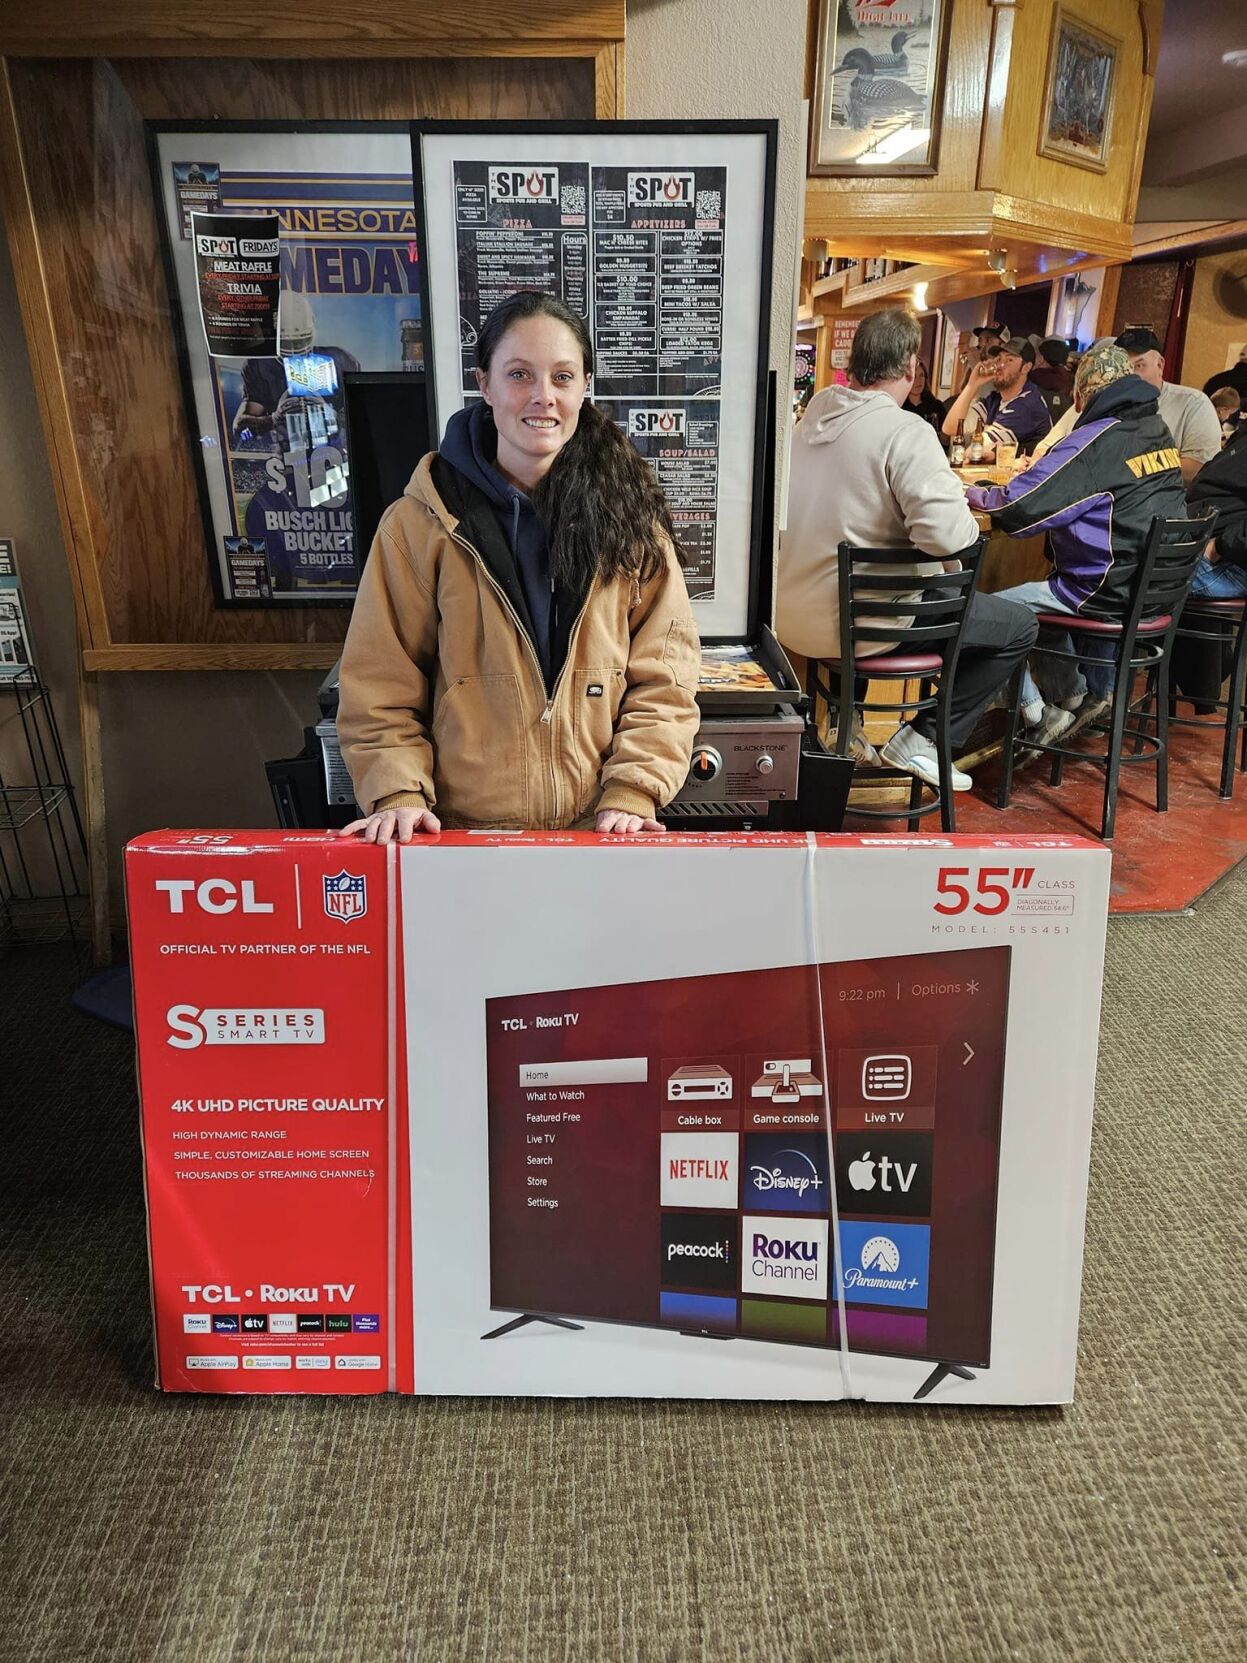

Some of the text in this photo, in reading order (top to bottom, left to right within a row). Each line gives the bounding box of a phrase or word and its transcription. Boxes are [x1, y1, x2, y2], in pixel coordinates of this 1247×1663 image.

[496, 170, 555, 197] SPOT
[635, 176, 692, 200] SPOT
[270, 209, 417, 232] NNESOTA
[502, 219, 533, 229] PIZZA
[631, 220, 687, 229] APPETIZERS
[563, 236, 586, 244] Hours
[200, 239, 235, 254] SPOT
[244, 241, 278, 252] FRIDAYS
[214, 261, 272, 272] MEAT RAFFLE
[279, 246, 421, 295] MEDAY
[227, 283, 262, 293] TRIVIA
[635, 412, 683, 431] SPOT
[660, 449, 716, 457] SOUP/SALAD
[265, 511, 328, 531] BUSCH
[669, 513, 710, 521] VERAGES
[300, 553, 354, 565] 5 BOTTLES
[1038, 880, 1076, 889] CLASS
[155, 878, 274, 914] TCL
[329, 893, 362, 915] NFL
[932, 925, 1070, 934] MODEL: 55S451
[160, 944, 371, 955] OFFICIAL TV PARTNER OF THE NFL
[839, 982, 961, 1002] 9:22 pm Options
[166, 1004, 315, 1049] S SERIES
[502, 1013, 580, 1031] TCL Roku TV
[218, 1030, 315, 1039] SMART TV
[526, 1071, 549, 1080] Home
[526, 1090, 585, 1102] What to Watch
[171, 1098, 385, 1113] 4K UHD PICTURE QUALITY
[527, 1112, 581, 1123] Featured Free
[678, 1115, 722, 1125] Cable box
[753, 1113, 820, 1124] Game console
[864, 1112, 904, 1123] Live TV
[173, 1131, 287, 1140] HIGH DYNAMIC RANGE
[527, 1134, 556, 1144] Live TV
[174, 1150, 370, 1160] SIMPLE, CUSTOMIZABLE HOME SCREEN
[527, 1156, 553, 1165] Search
[176, 1170, 375, 1180] THOUSANDS OF STREAMING CHANNELS
[669, 1160, 729, 1181] NETFLIX
[878, 1156, 918, 1193] tv
[527, 1177, 548, 1186] Store
[528, 1198, 559, 1208] Settings
[668, 1241, 724, 1261] peacock
[752, 1234, 819, 1261] Roku
[752, 1260, 818, 1281] Channel
[842, 1268, 919, 1291] Paramount+
[182, 1284, 356, 1303] TCL Roku TV
[253, 1318, 264, 1328] tv
[328, 1320, 349, 1328] hulu
[218, 1360, 237, 1368] AirPlay
